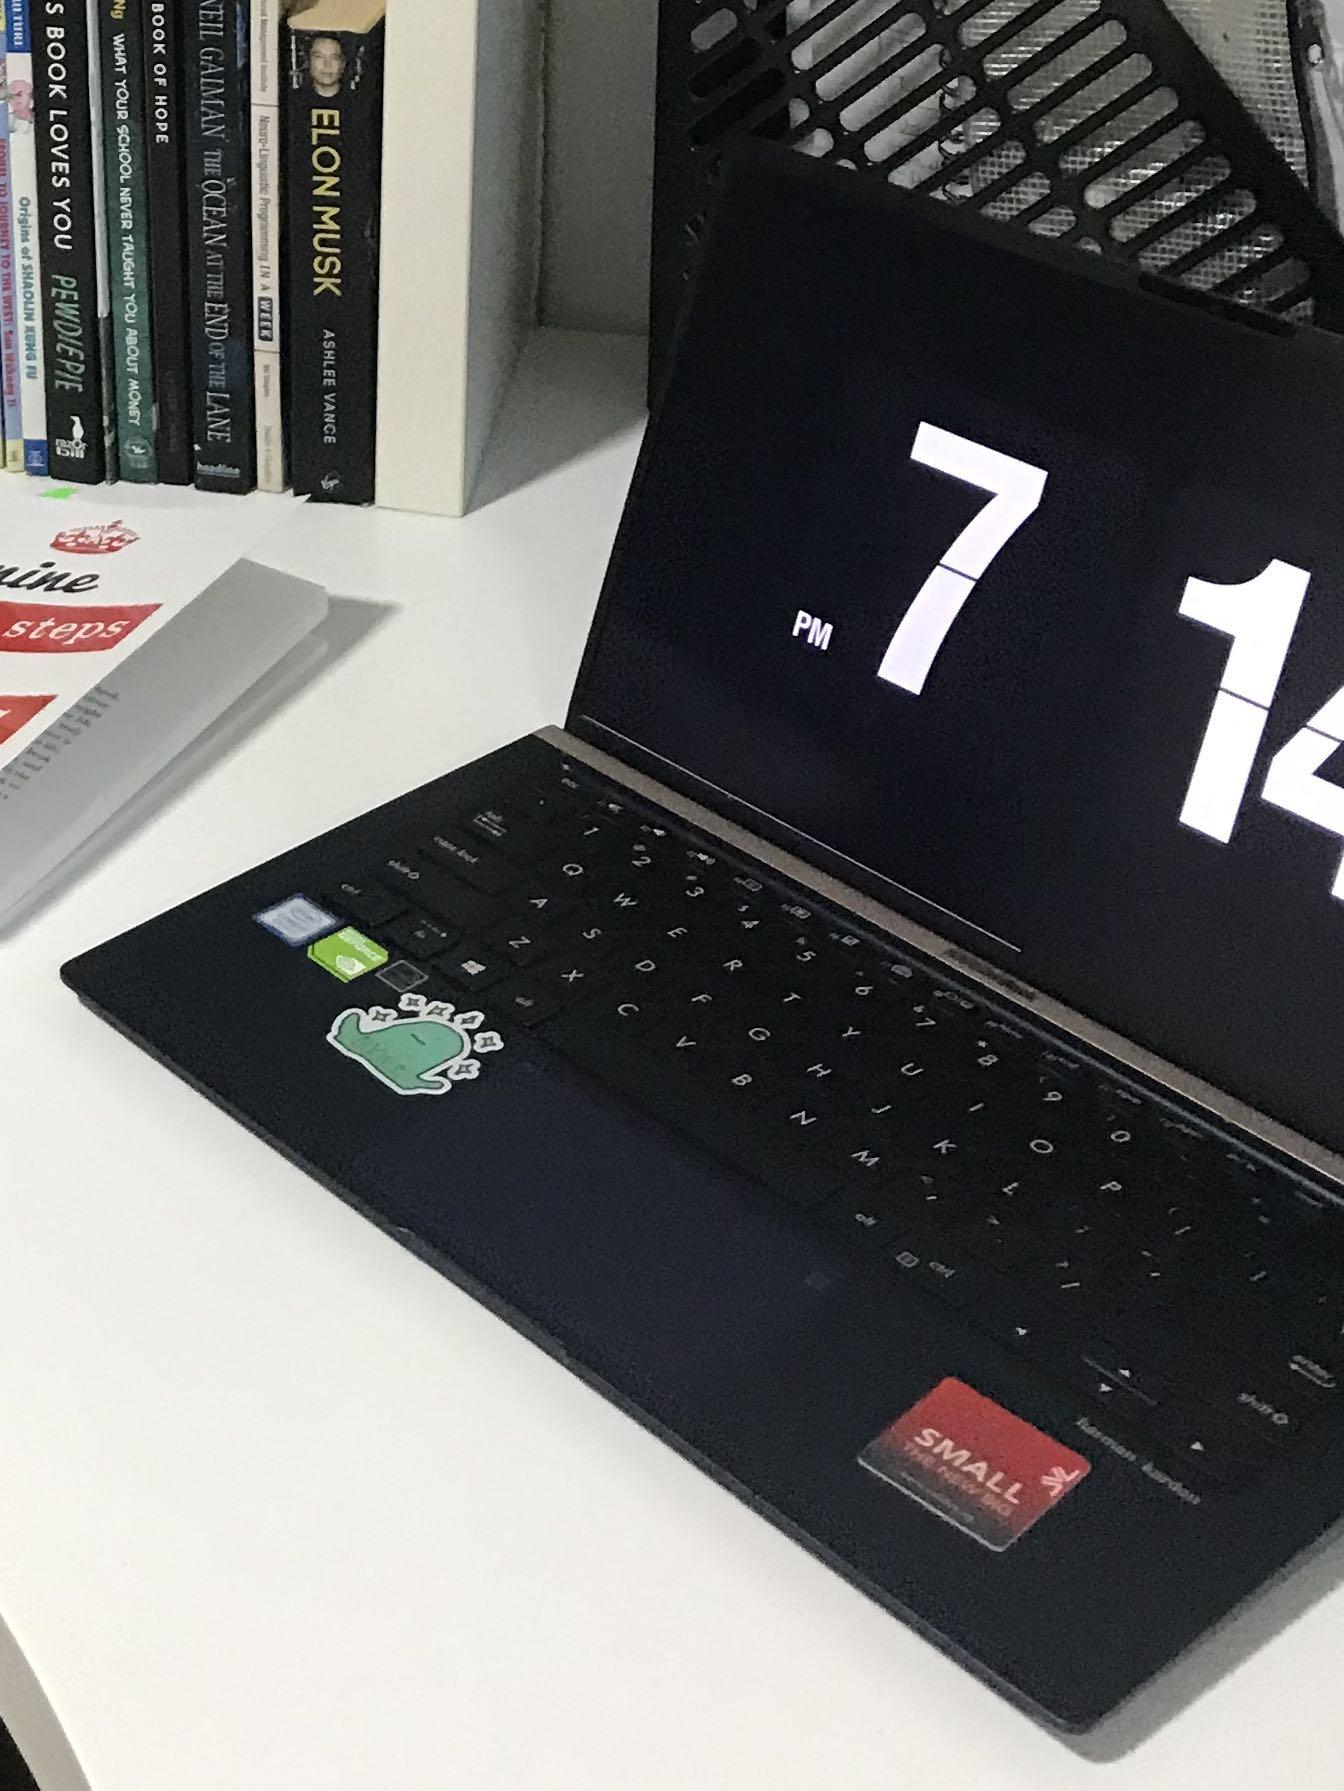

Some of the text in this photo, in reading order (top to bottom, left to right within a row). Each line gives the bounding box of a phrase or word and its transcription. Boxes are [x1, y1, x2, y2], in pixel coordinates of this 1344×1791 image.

[151, 3, 167, 56] BOOK
[45, 26, 67, 99] BOOK
[154, 63, 167, 87] OF
[154, 95, 169, 144] HOPE
[200, 47, 226, 140] GAIMAN
[48, 109, 71, 188] LOVES
[257, 115, 270, 196] Neuro-Linguistic
[52, 197, 73, 250] YOU
[256, 196, 270, 262] Programming
[311, 108, 342, 297] ELON MUSK
[112, 33, 141, 426] WHAT YOUR SCHOOL NEVER TAUGHT YOU ABOUT MONEY
[17, 197, 37, 361] Origins SHAOLIN KUNG
[201, 148, 231, 443] THE OCEAN AT THE END OF THE LANE
[51, 274, 86, 393] PEWDIEPIE
[259, 299, 272, 339] WEEK
[323, 328, 336, 445] ASHLEE VANCE
[877, 420, 1048, 696] 7
[2, 613, 128, 647] steps
[792, 609, 835, 651] PM
[562, 862, 584, 877] Q
[528, 896, 549, 909] A
[613, 892, 638, 910] W
[582, 927, 603, 940] S
[666, 925, 688, 939] E
[790, 1110, 818, 1127] N
[933, 1139, 956, 1155] K
[914, 1427, 1023, 1505] SMALL
